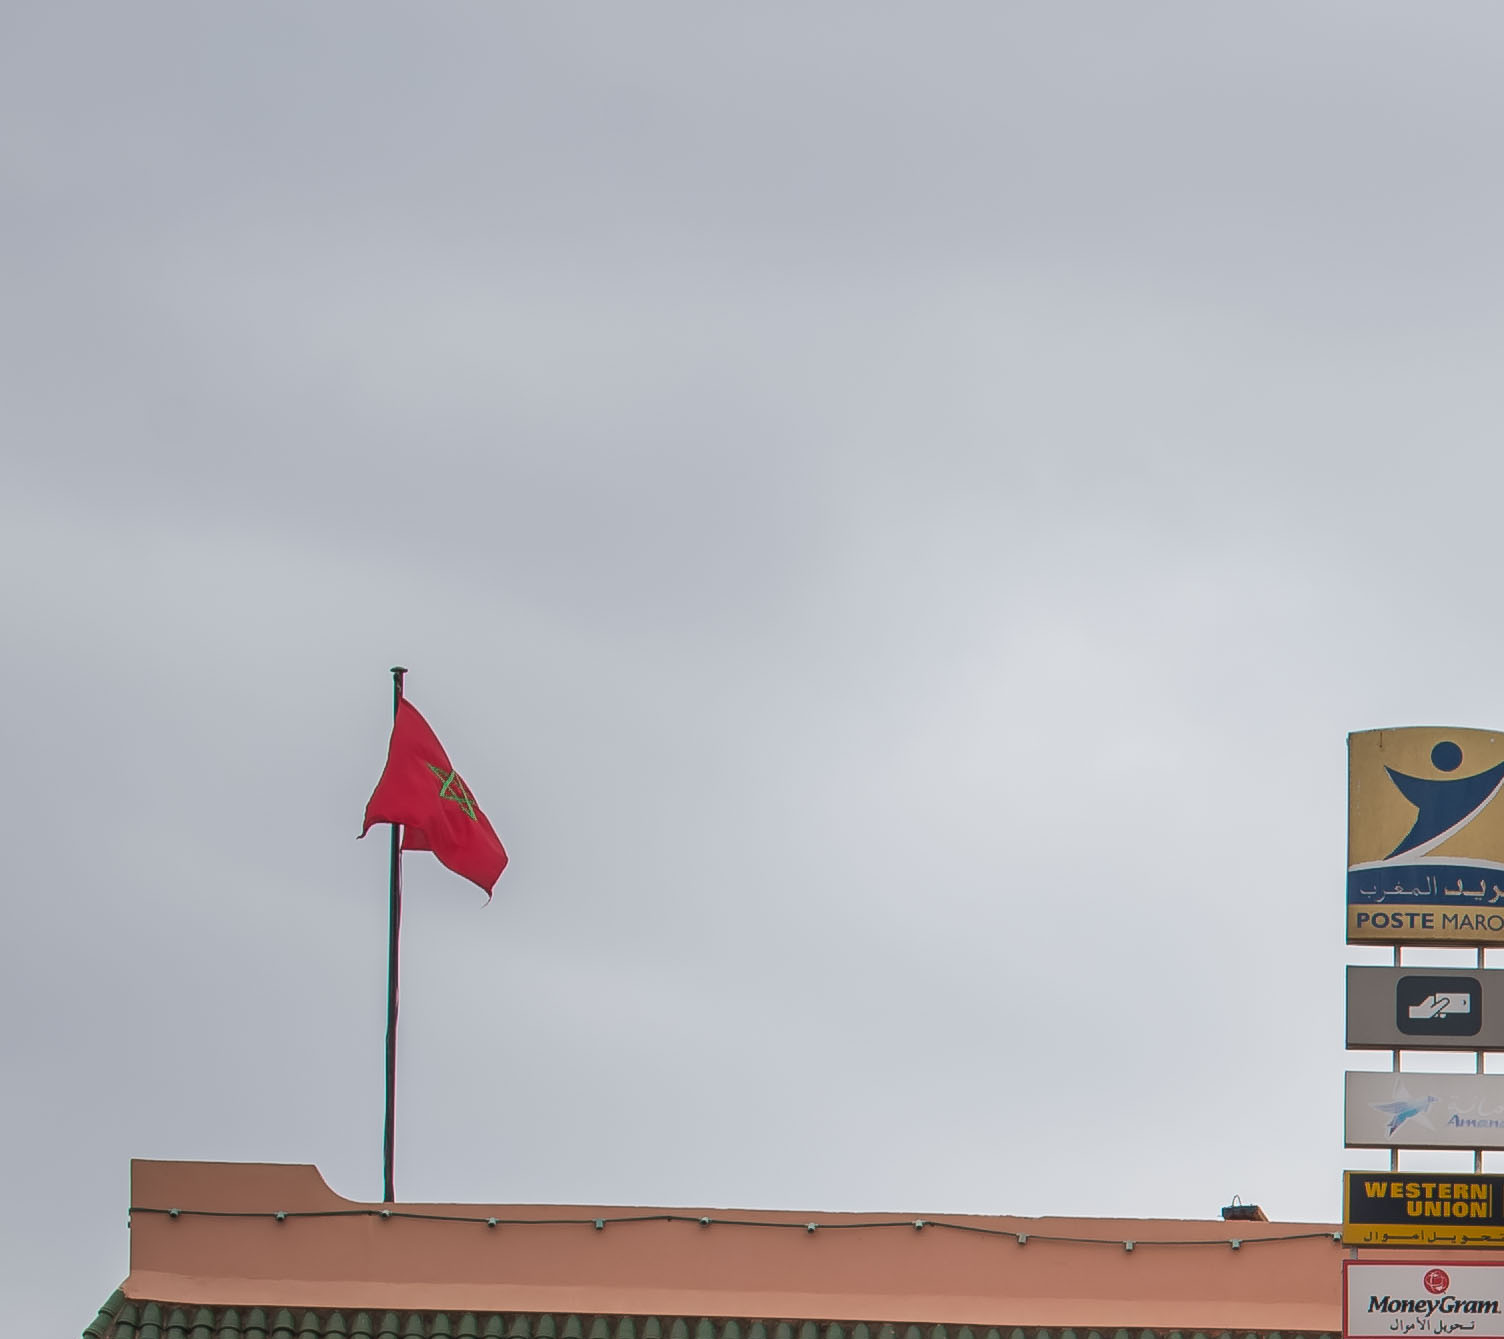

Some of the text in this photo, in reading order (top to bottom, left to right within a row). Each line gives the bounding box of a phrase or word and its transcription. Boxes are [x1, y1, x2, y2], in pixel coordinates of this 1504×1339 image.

[1360, 875, 1438, 903] المغرب
[1357, 912, 1434, 929] POSTE
[1364, 1182, 1488, 1200] WESTERN
[1407, 1200, 1488, 1218] UNION
[1368, 1296, 1500, 1317] MoneyGram
[1390, 1317, 1475, 1335] تحويل الأموال
